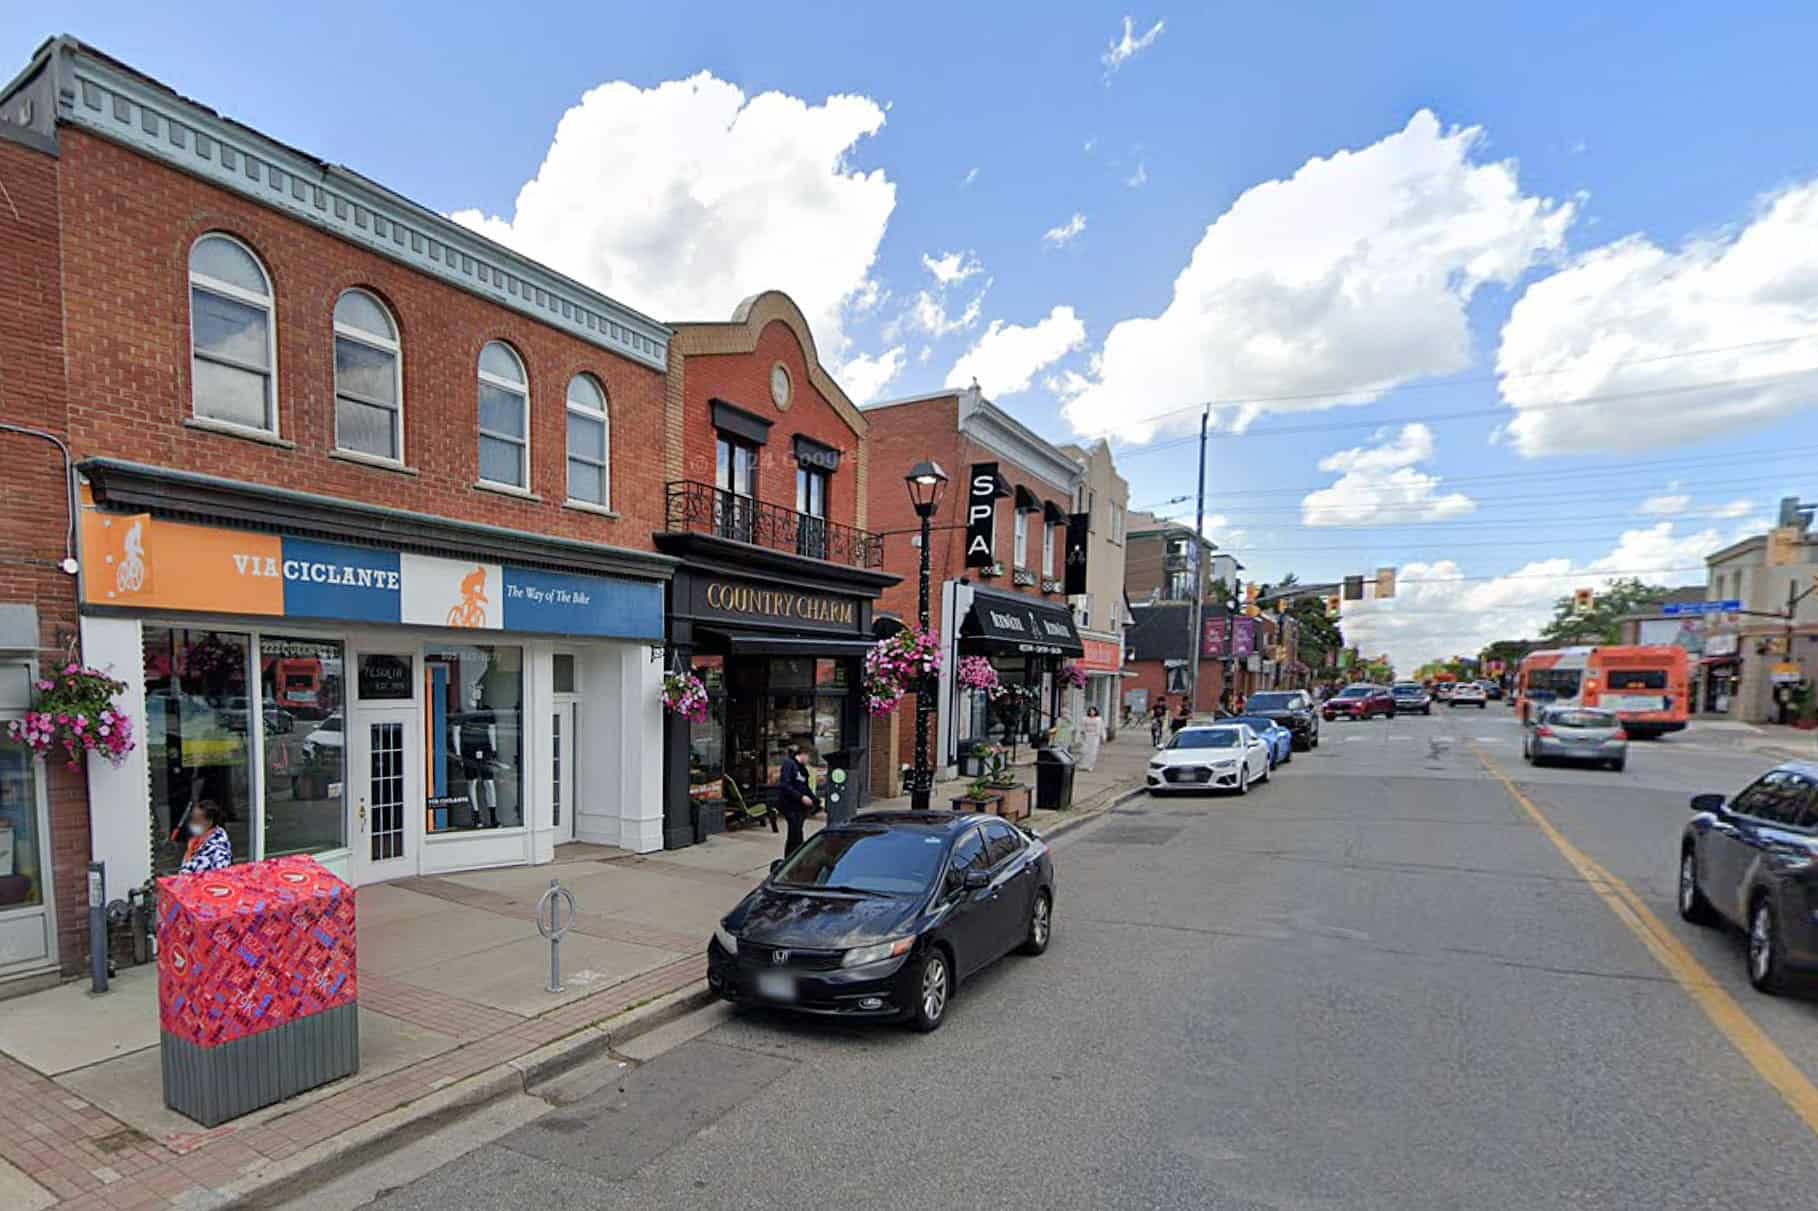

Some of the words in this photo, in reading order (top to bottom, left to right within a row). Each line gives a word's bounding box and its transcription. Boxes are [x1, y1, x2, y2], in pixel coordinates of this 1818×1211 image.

[967, 475, 995, 555] SPA
[233, 554, 279, 577] VIA
[283, 560, 399, 590] CICLANTE
[506, 584, 524, 598] The
[525, 586, 544, 603] Way
[545, 588, 555, 604] of
[556, 589, 571, 603] The
[572, 591, 591, 605] Bike
[707, 583, 794, 616] COUNTRY
[796, 596, 853, 624] CHARM
